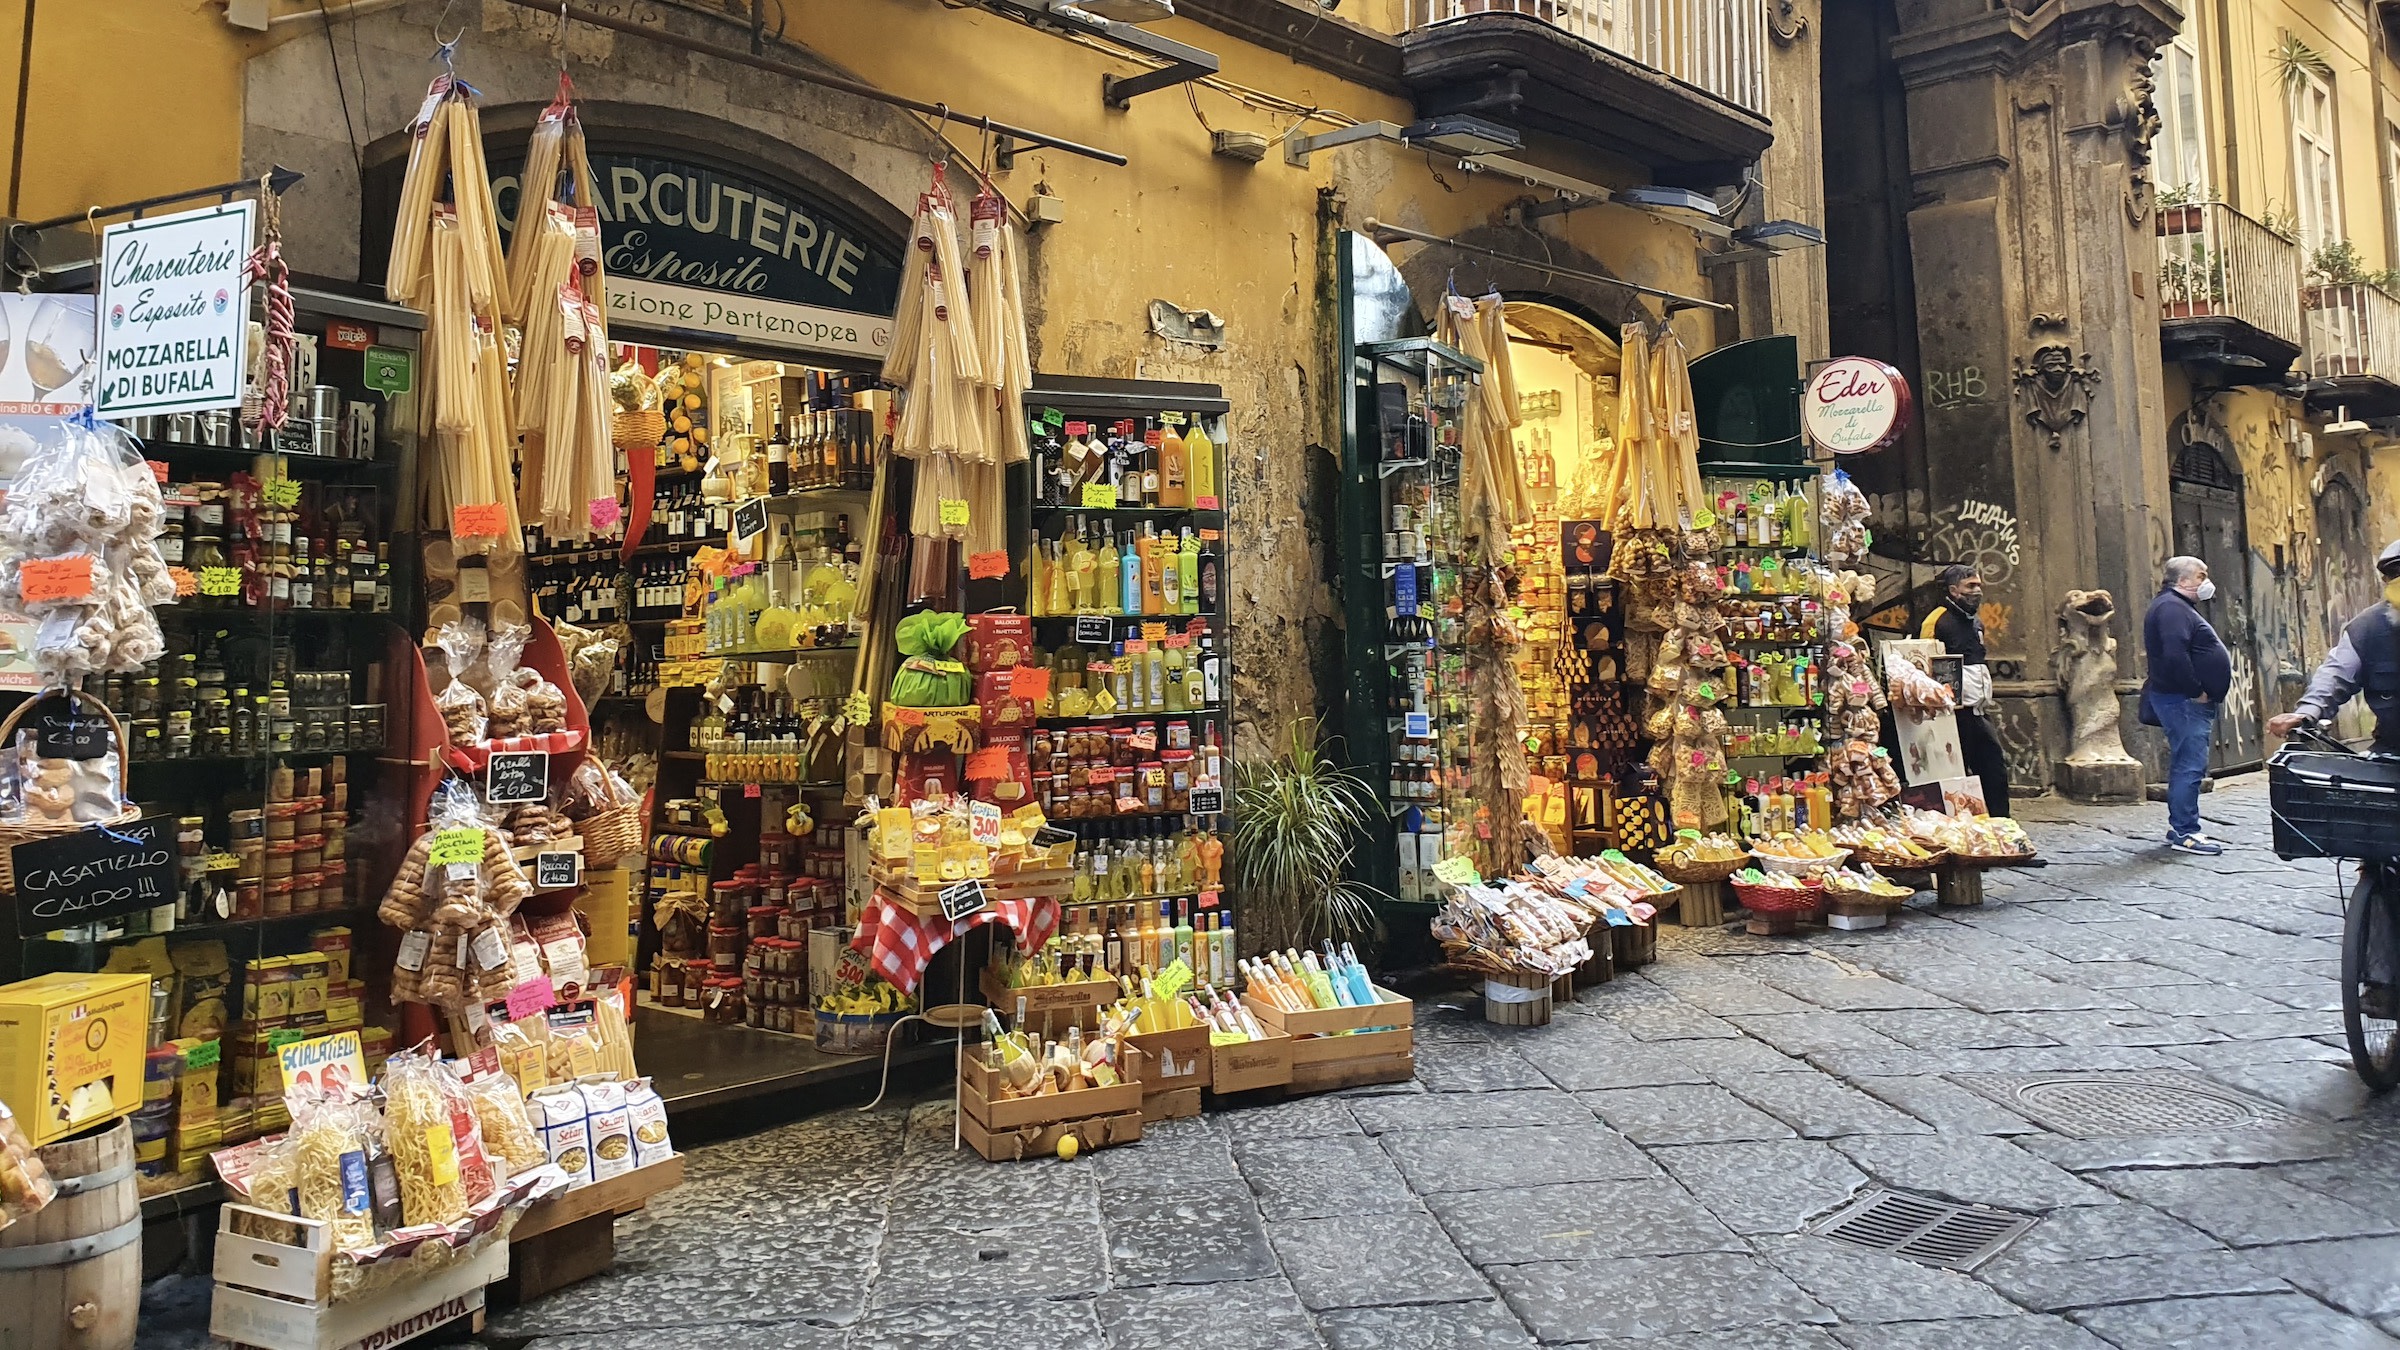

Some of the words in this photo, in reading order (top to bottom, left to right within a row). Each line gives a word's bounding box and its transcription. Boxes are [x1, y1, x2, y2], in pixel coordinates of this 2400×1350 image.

[490, 166, 866, 296] CRCUTERIE
[111, 239, 235, 288] Charcuterie
[605, 230, 769, 291] Esposito
[129, 288, 207, 332] Esposito
[605, 287, 694, 320] izione
[703, 300, 859, 343] Partenopea
[107, 336, 229, 371] MOZZARELLA
[369, 351, 407, 363] RECENSITO
[117, 376, 137, 399] DI
[141, 368, 214, 394] BUFALA
[1817, 369, 1886, 404] Eder
[1926, 366, 1988, 401] RHB
[0, 403, 17, 413] ino
[21, 404, 41, 414] BIO
[1817, 401, 1885, 418] Mozzarella
[1844, 416, 1858, 430] di
[1830, 428, 1874, 445] Bufala
[990, 735, 1020, 743] BALOCCO
[110, 826, 156, 843] OGGI
[24, 850, 169, 891] CASATIELLO
[32, 887, 132, 917] CALDO
[138, 877, 161, 898] !!!
[282, 1034, 357, 1071] SCIALATIELLI
[360, 1295, 468, 1350] VITALUNGA
